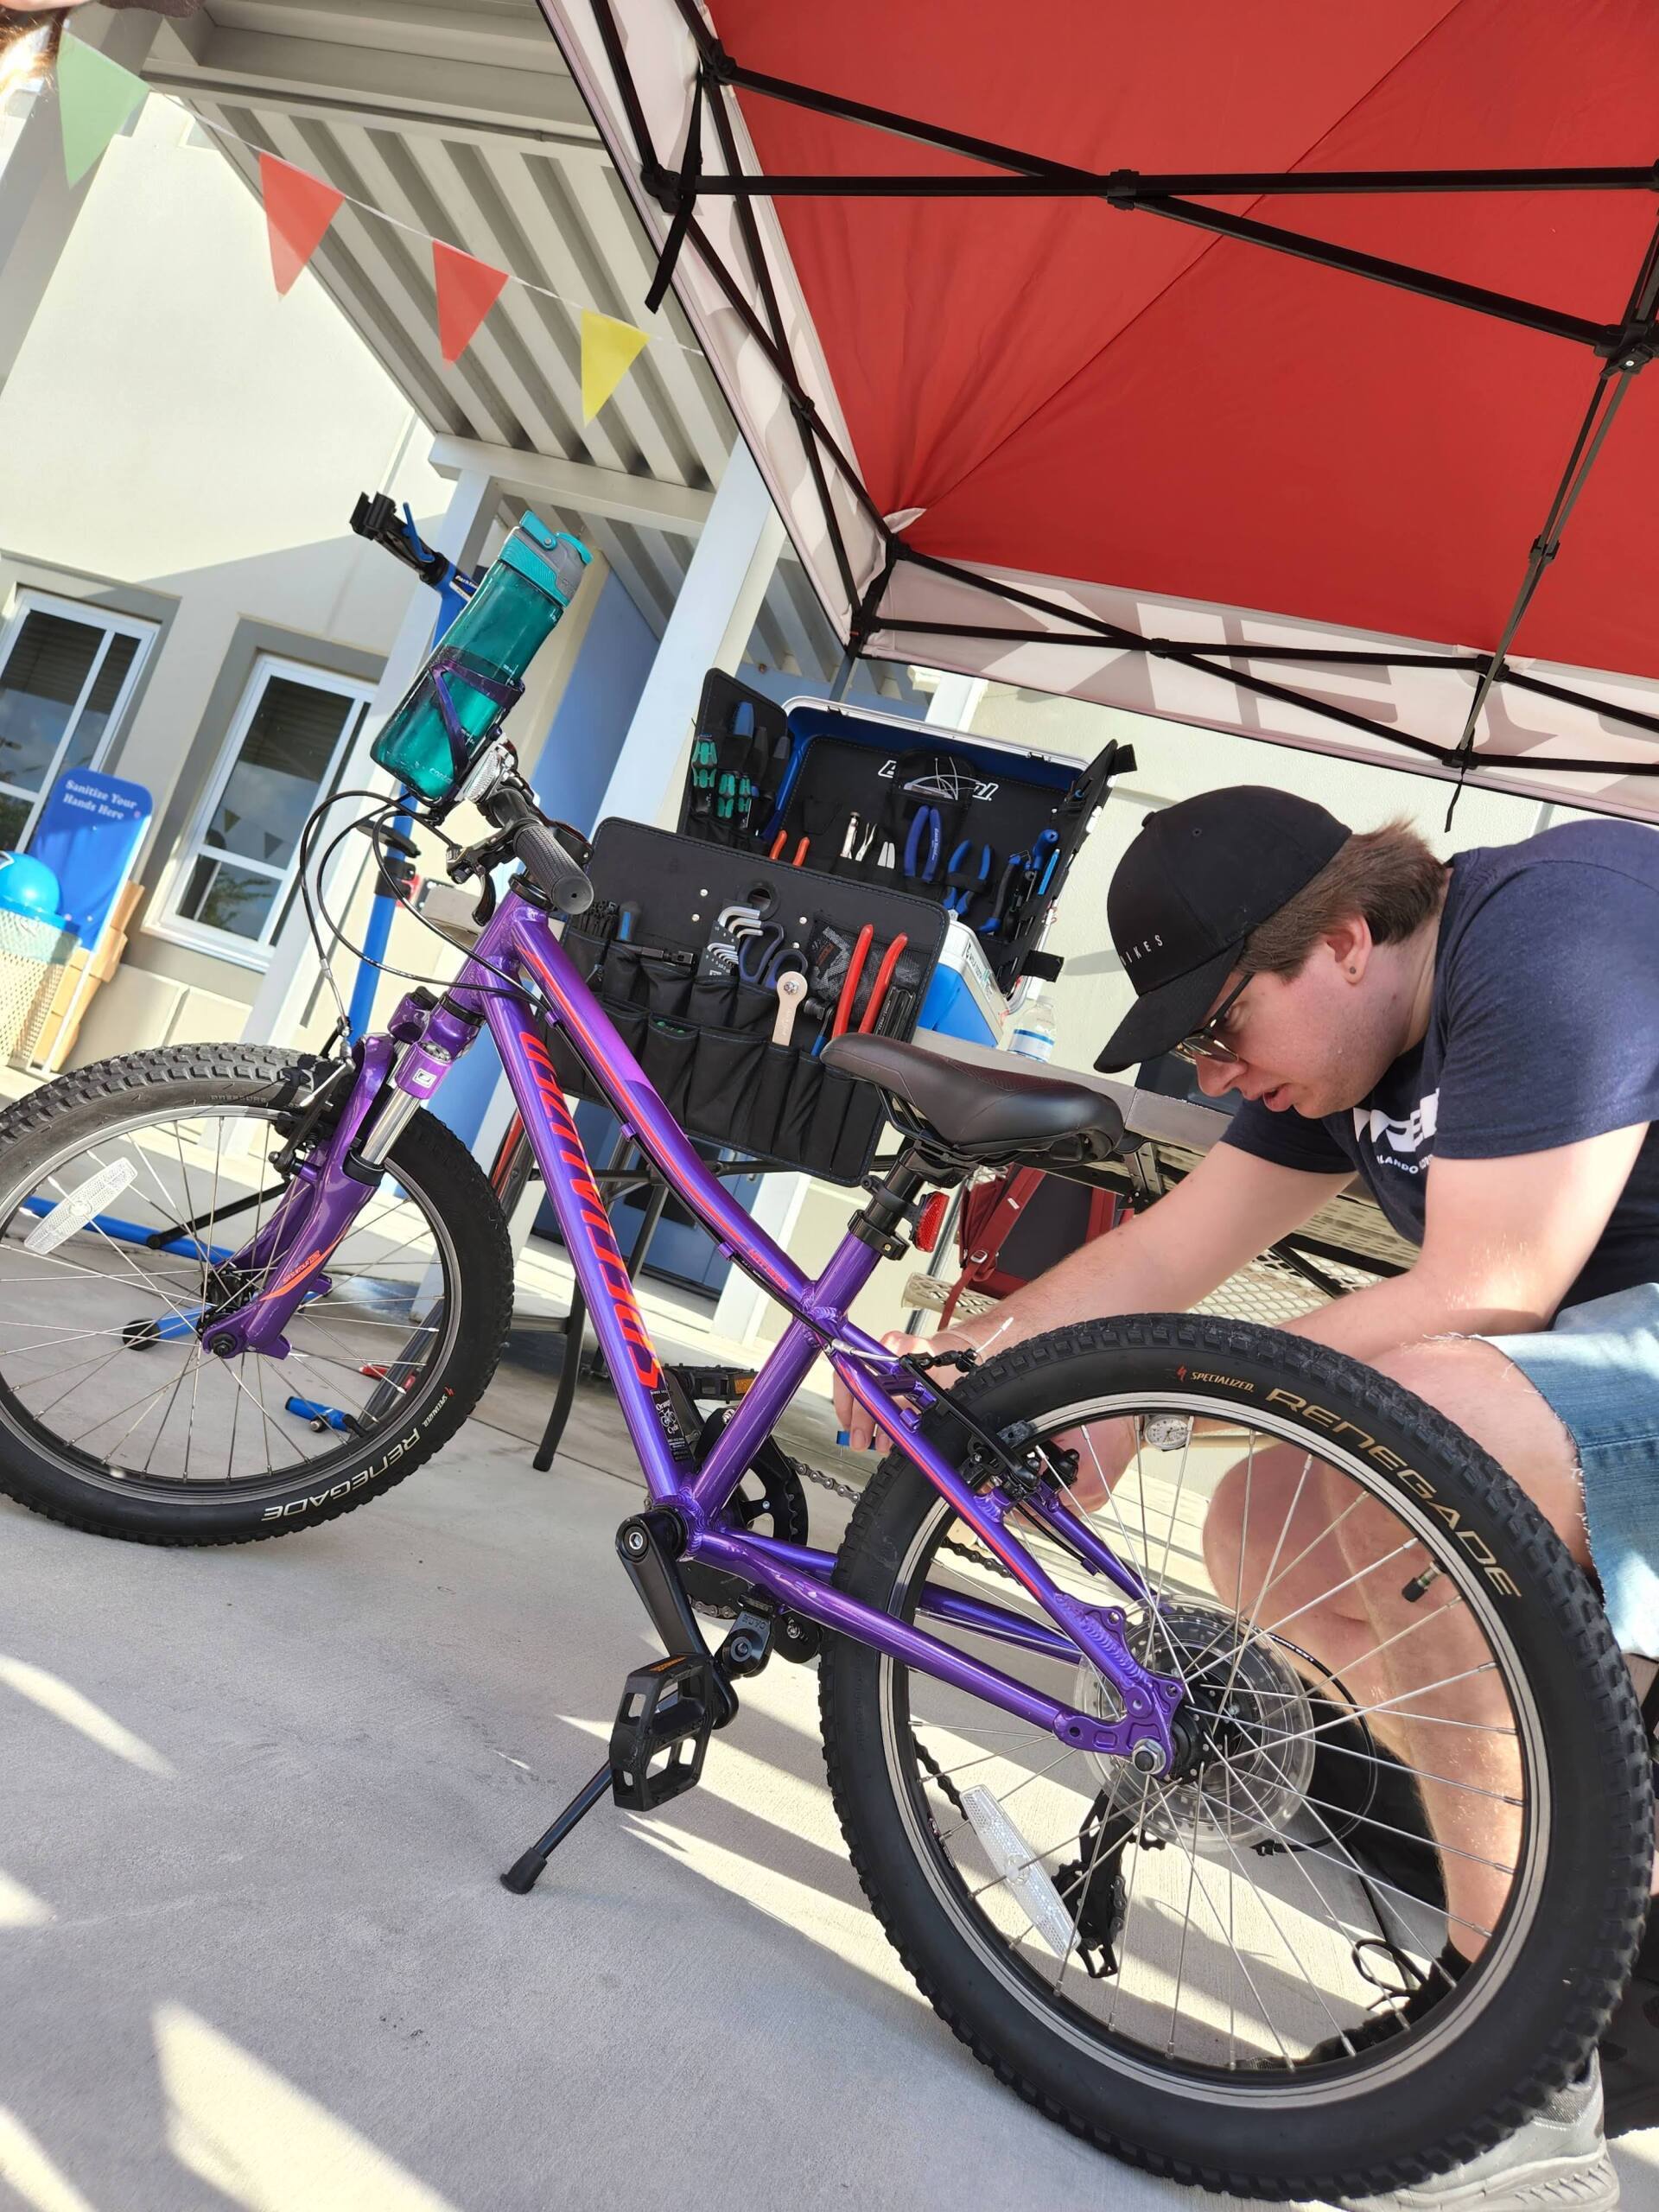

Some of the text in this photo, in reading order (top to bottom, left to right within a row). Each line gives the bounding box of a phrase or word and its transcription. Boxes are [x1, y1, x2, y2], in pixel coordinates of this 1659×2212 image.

[62, 792, 125, 821] Hands Here
[65, 779, 138, 810] Sanitize Your
[261, 1427, 422, 1522] RENEGADE
[1264, 1387, 1522, 1599] RENEGADE
